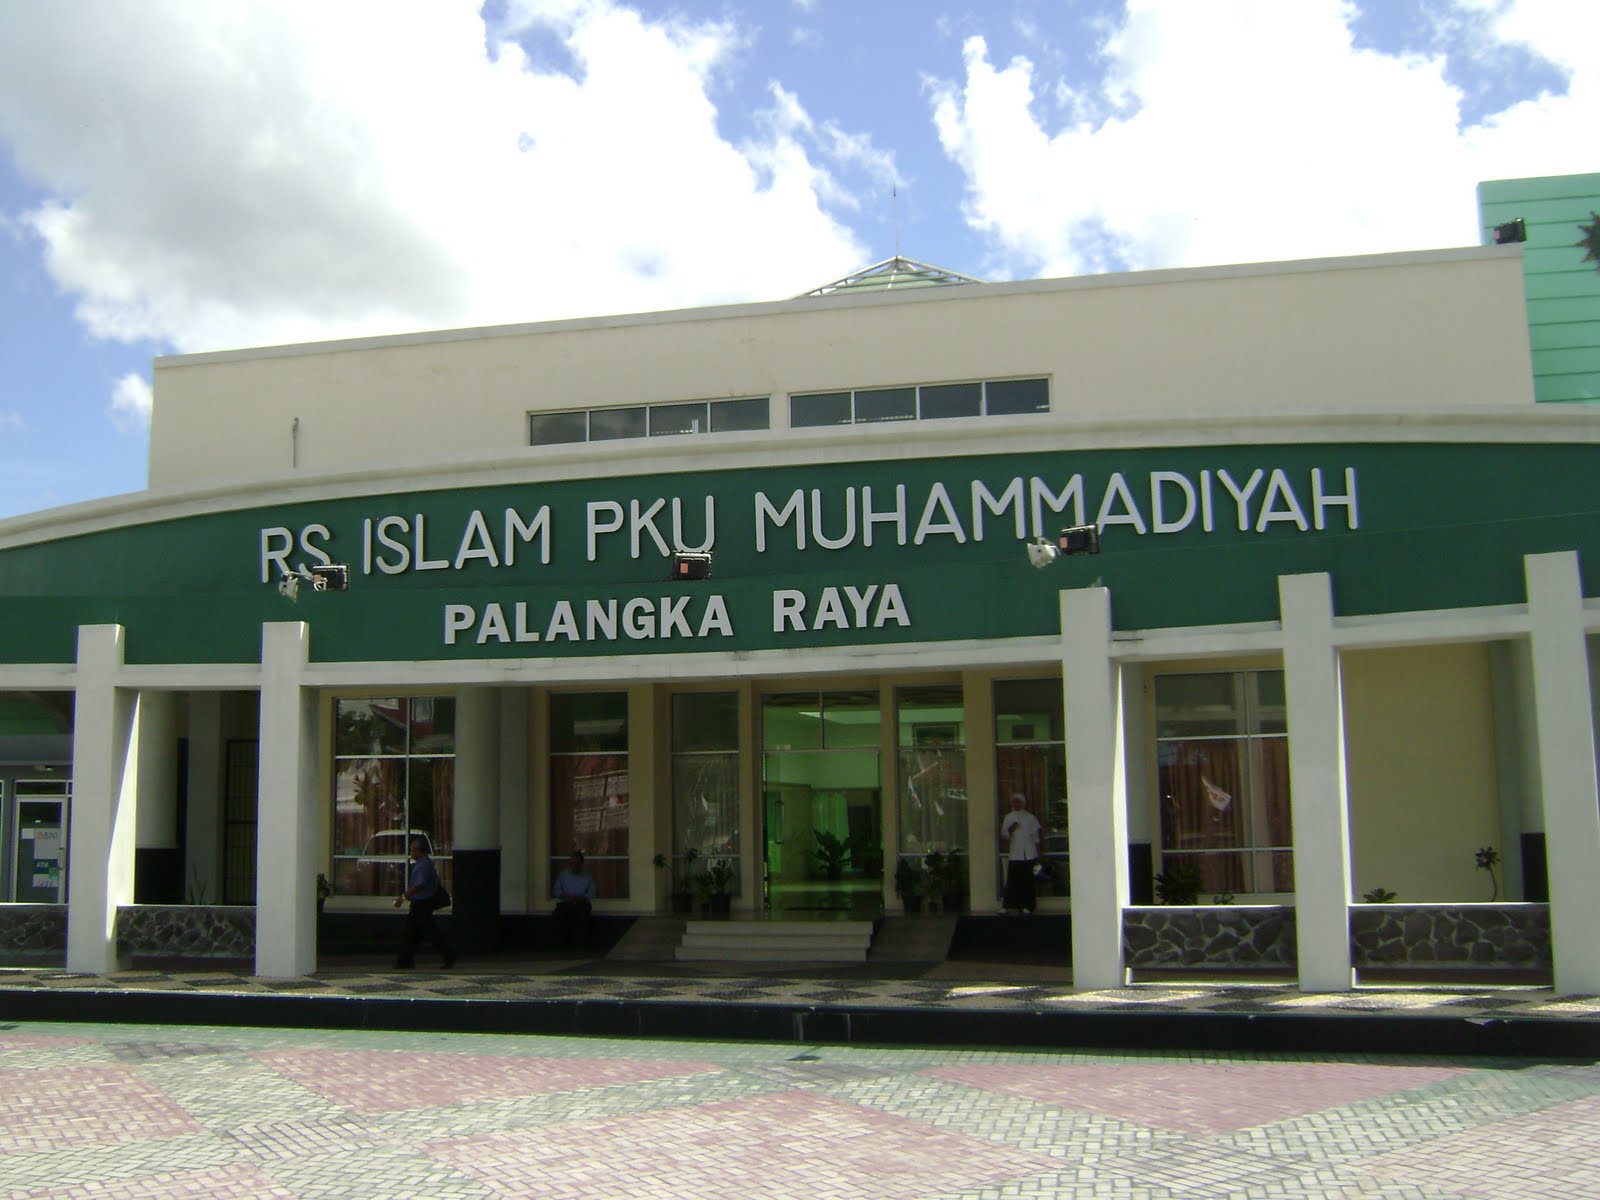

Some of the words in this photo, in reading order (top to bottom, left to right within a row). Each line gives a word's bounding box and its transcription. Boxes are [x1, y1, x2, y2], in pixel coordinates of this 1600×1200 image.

[261, 523, 331, 584] RS
[363, 505, 550, 575] ISLAM
[587, 495, 715, 561] PKU
[755, 467, 1358, 552] MUHAMMADIYAH
[444, 595, 734, 645] PALANGKA
[773, 584, 911, 632] RAYA
[44, 831, 58, 840] BNI
